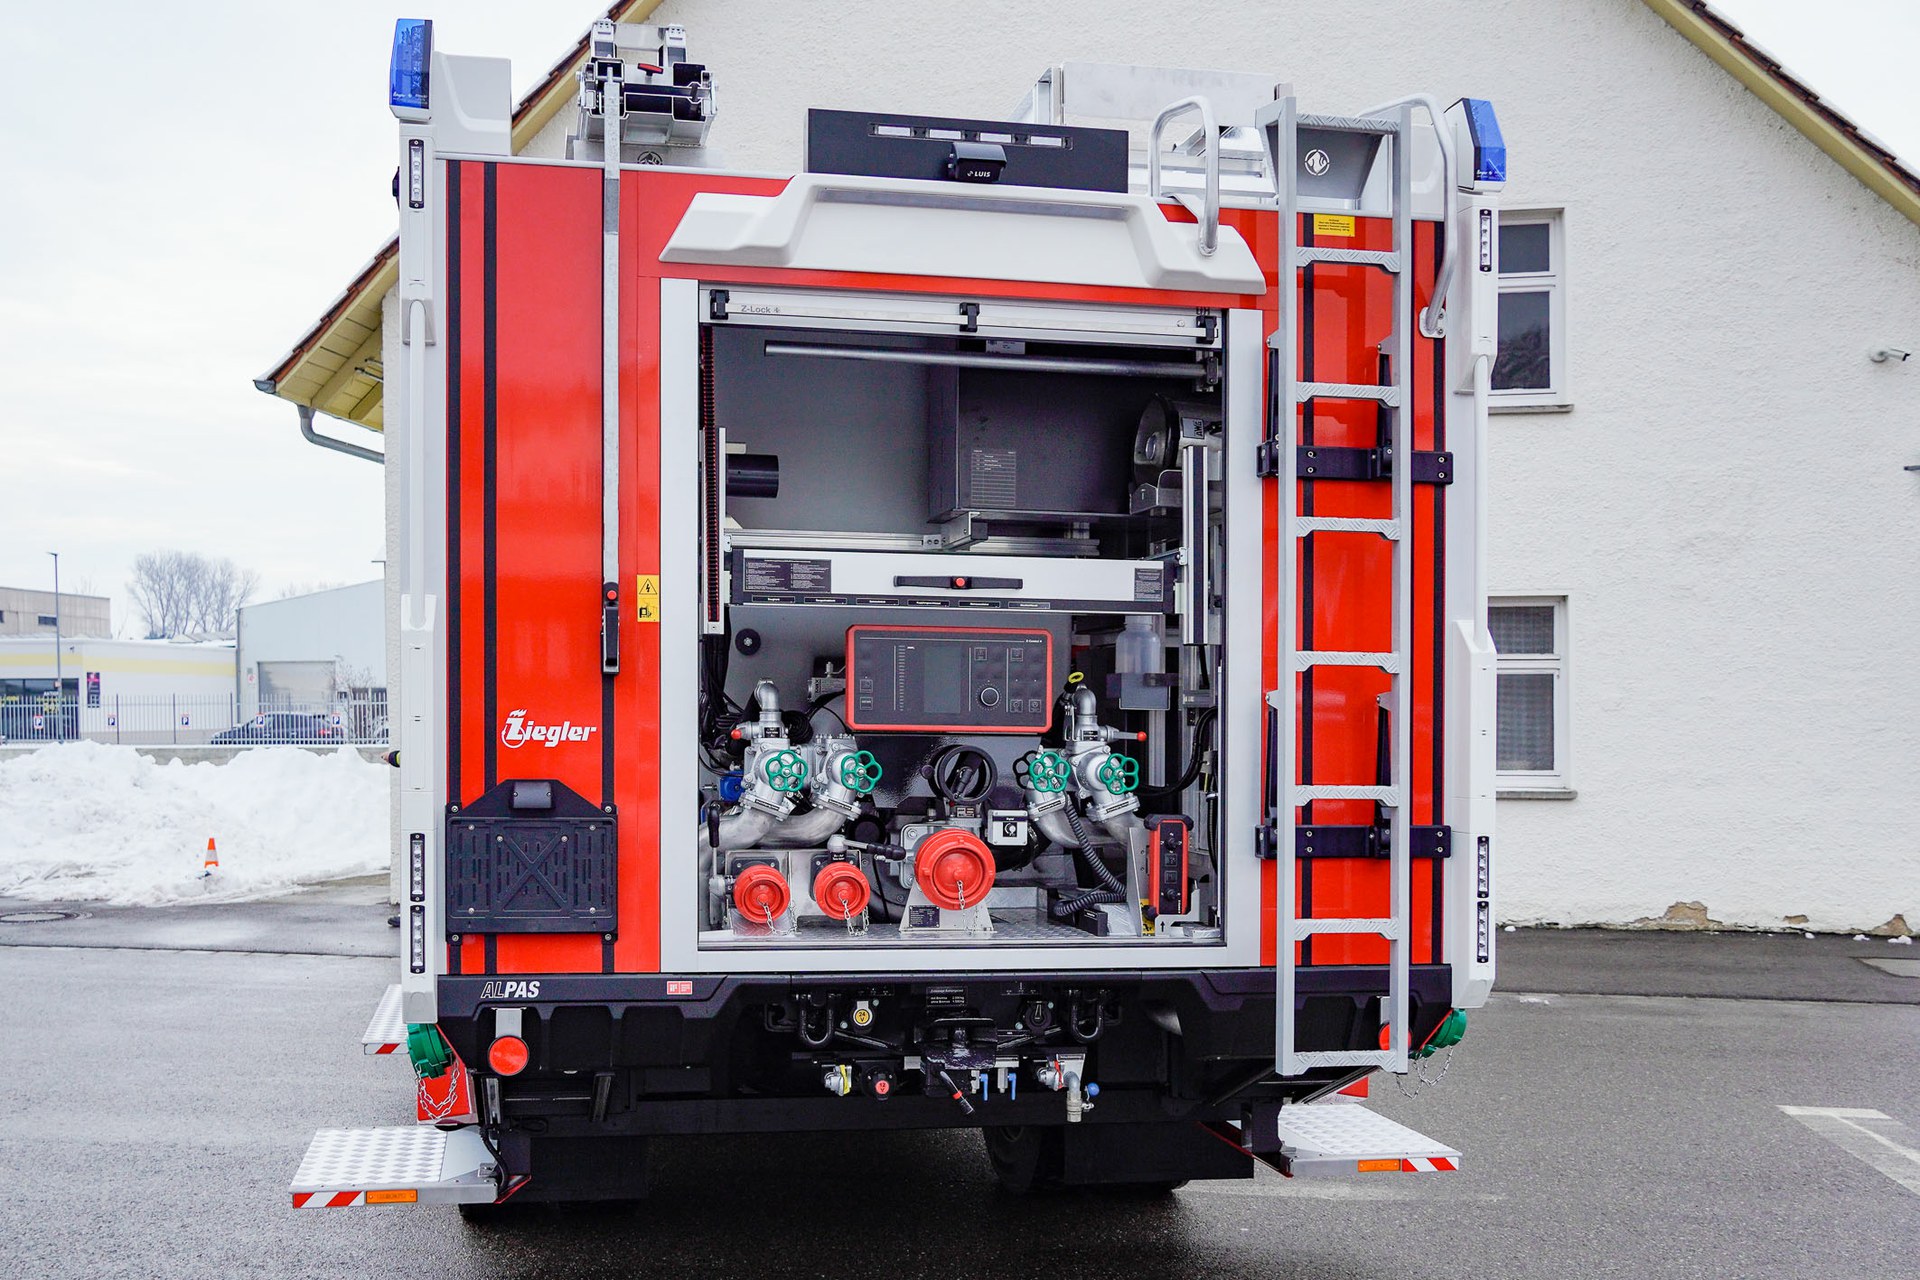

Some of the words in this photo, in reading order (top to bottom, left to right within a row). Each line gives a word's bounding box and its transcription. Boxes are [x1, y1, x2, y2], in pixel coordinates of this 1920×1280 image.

[741, 304, 771, 313] Z-Lock
[501, 708, 598, 749] Ziegler
[480, 980, 541, 999] ALPAS
